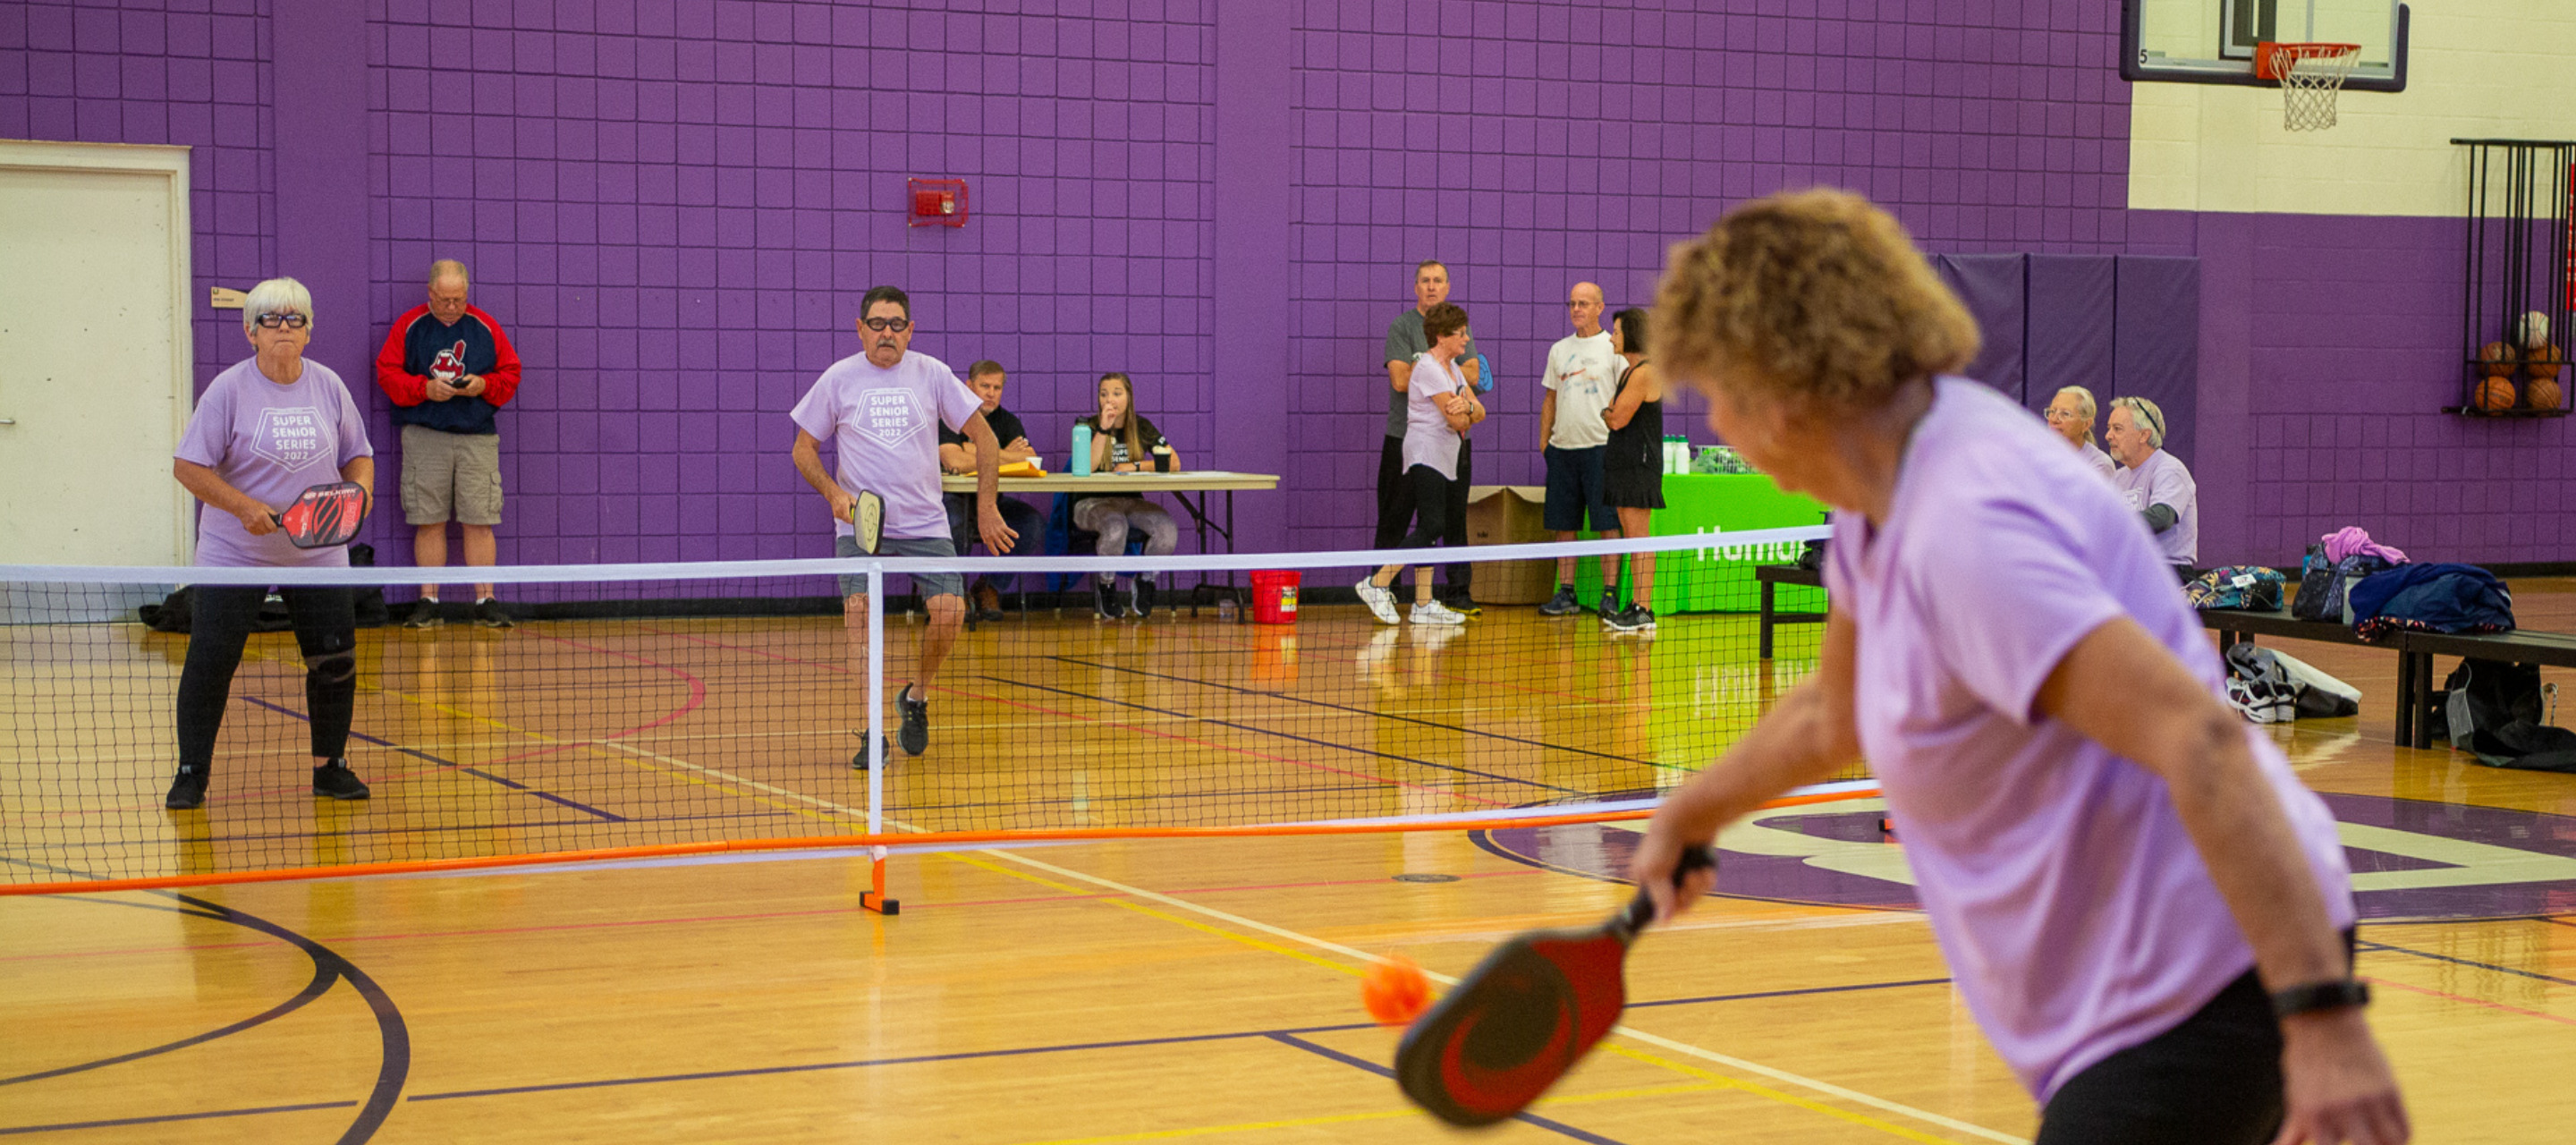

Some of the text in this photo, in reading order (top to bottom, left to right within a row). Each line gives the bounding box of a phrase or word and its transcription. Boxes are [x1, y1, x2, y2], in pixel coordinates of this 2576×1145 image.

[2140, 48, 2148, 64] 5
[871, 395, 905, 405] SUPER
[869, 406, 909, 417] SENIOR
[272, 415, 311, 427] SUPER
[871, 417, 909, 428] SERIES
[272, 427, 317, 437] SENIOR
[879, 428, 902, 437] 2022
[275, 439, 316, 450] SERIES
[284, 452, 309, 461] 2022
